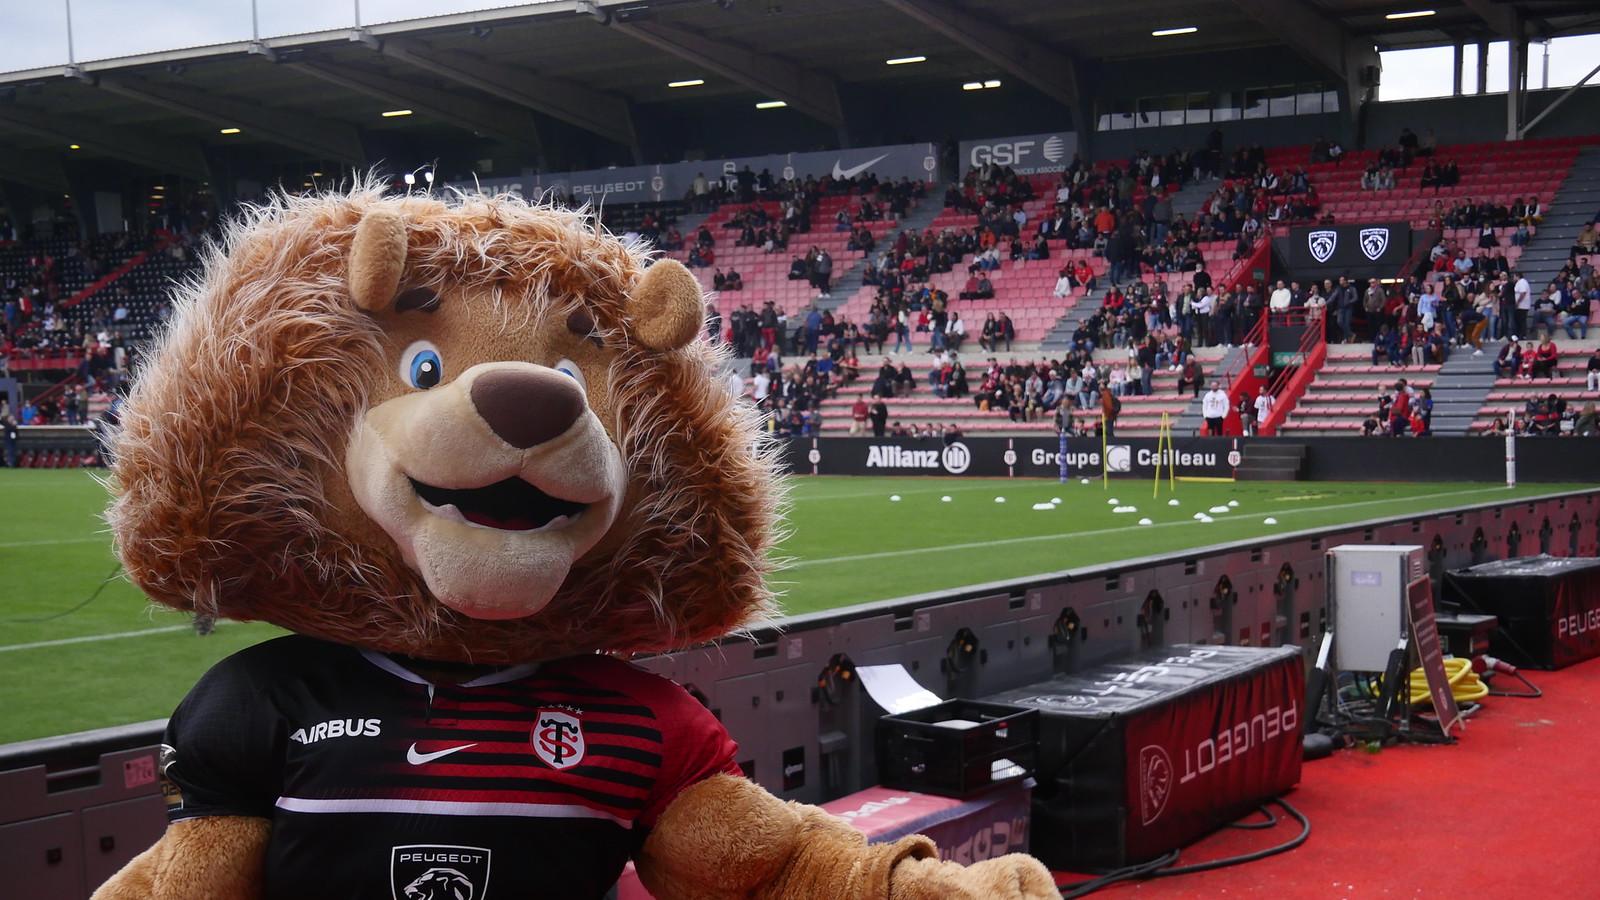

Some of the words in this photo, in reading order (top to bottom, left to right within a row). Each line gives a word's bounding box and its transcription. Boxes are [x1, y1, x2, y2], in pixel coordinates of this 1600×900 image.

[971, 141, 1035, 168] GSF
[573, 181, 646, 195] PEUGEOT
[866, 445, 940, 468] Allianz
[1137, 448, 1217, 466] Cailleau
[289, 718, 382, 745] AIRBUS
[1180, 700, 1297, 784] PEUGEOT
[400, 853, 483, 864] PEUGEOT
